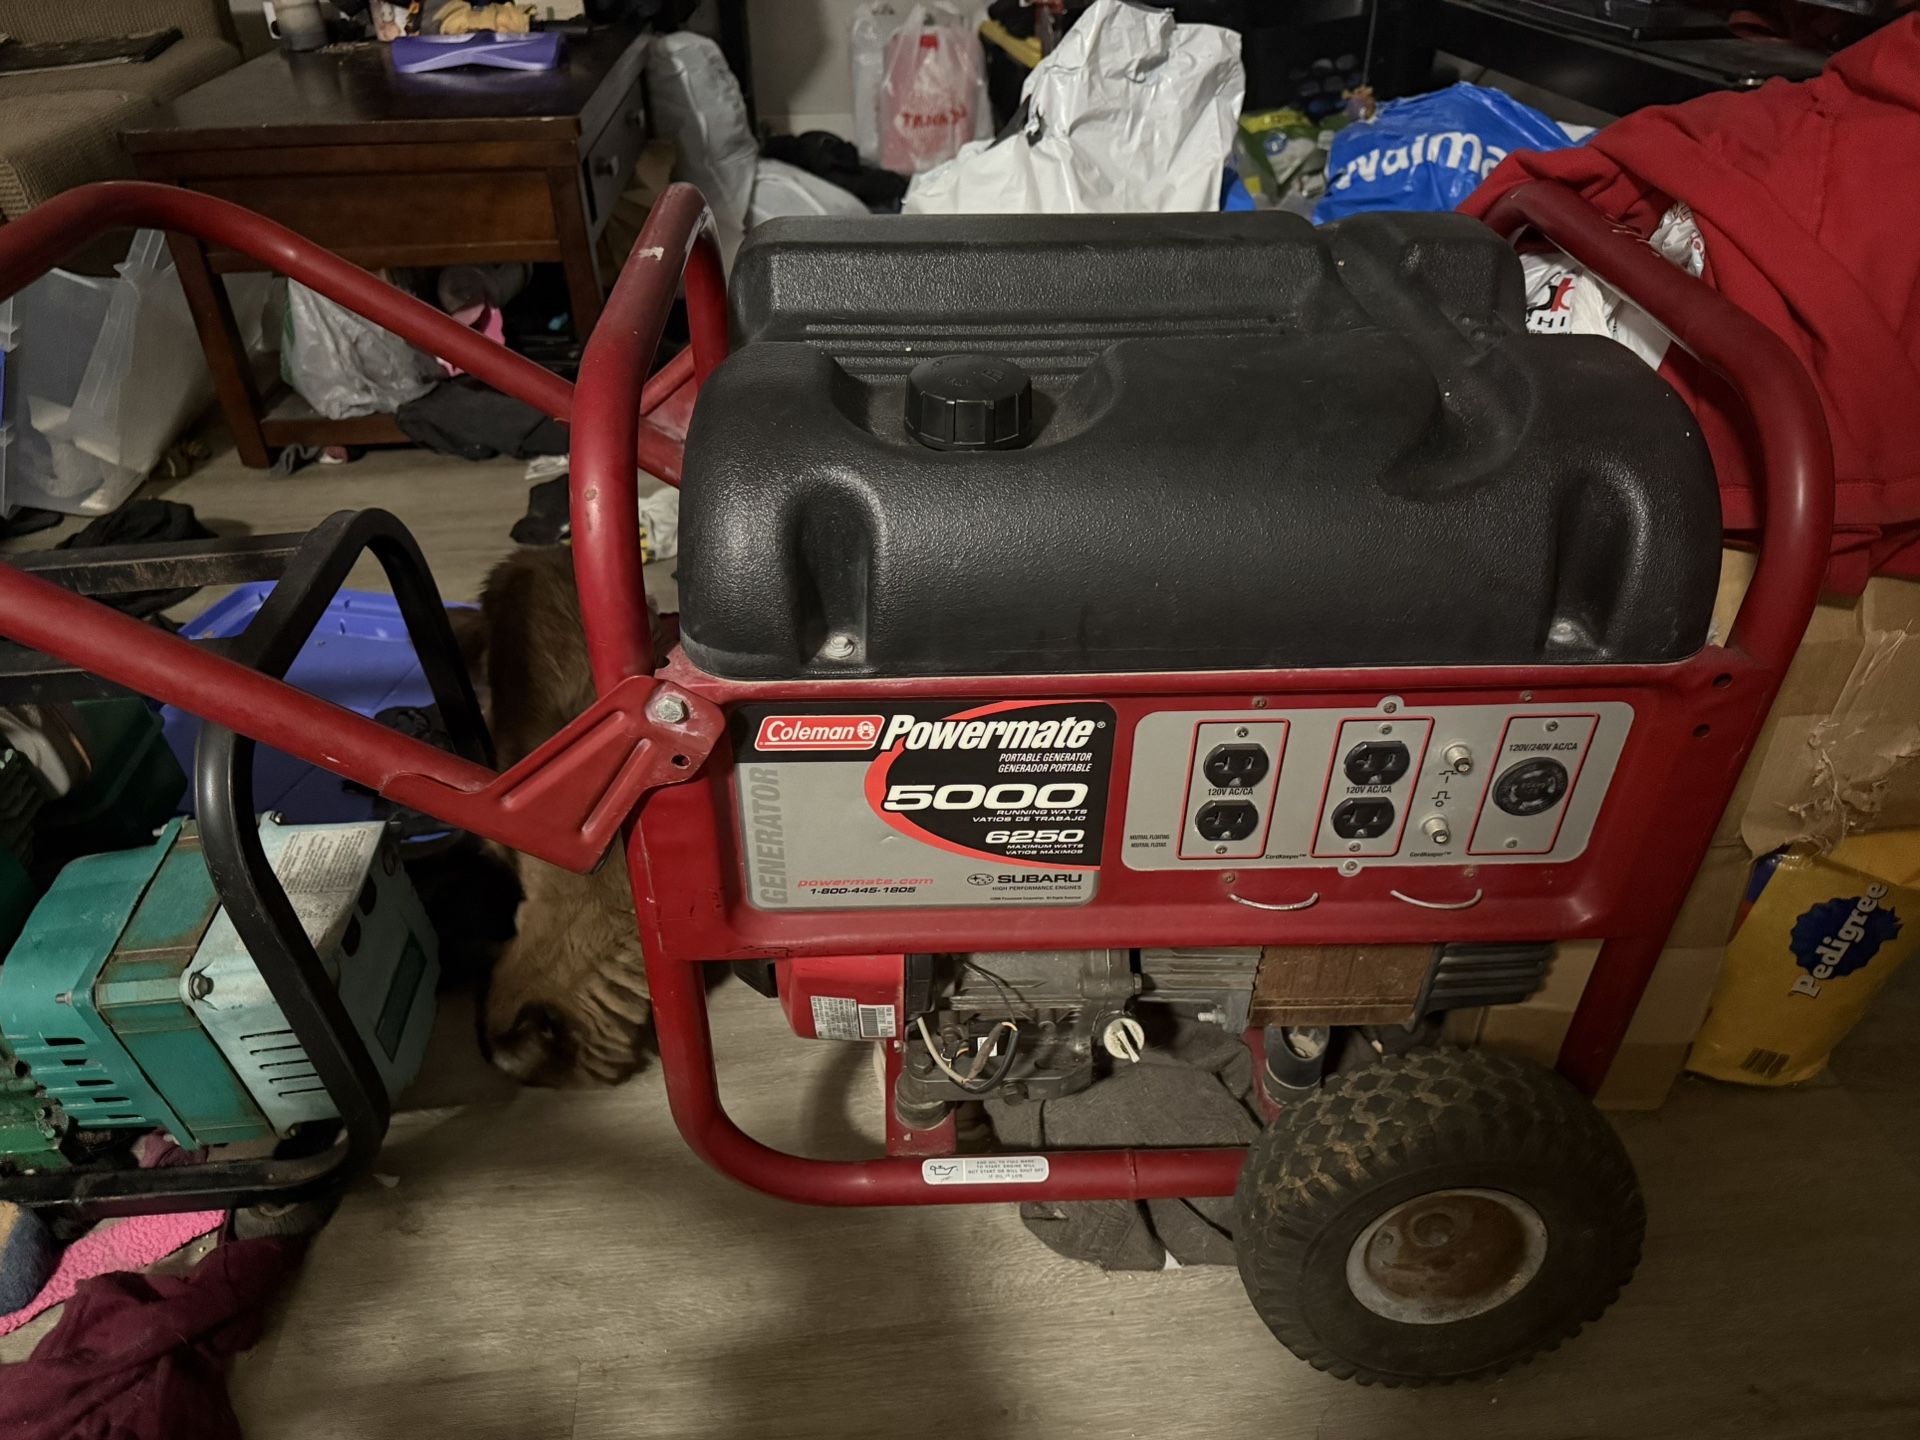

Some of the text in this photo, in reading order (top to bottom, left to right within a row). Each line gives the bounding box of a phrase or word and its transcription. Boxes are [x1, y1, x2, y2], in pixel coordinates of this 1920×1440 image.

[1335, 131, 1508, 190] Walma
[766, 720, 855, 741] Coleman
[1509, 742, 1578, 752] 120V/240V AC/CA
[999, 752, 1093, 762] PORTABLE GENERATOR
[998, 763, 1093, 773] GENERADOR PORTABLE
[1207, 787, 1253, 796] 120V AC/CA
[1345, 785, 1392, 794] 120V AC/CA
[884, 783, 1088, 811] 5000
[749, 766, 788, 904] GENERATOR
[985, 829, 1085, 844] 6250
[797, 877, 935, 888] powermate.com
[997, 873, 1083, 884] SUBARU
[1791, 881, 1889, 998] Pedigree
